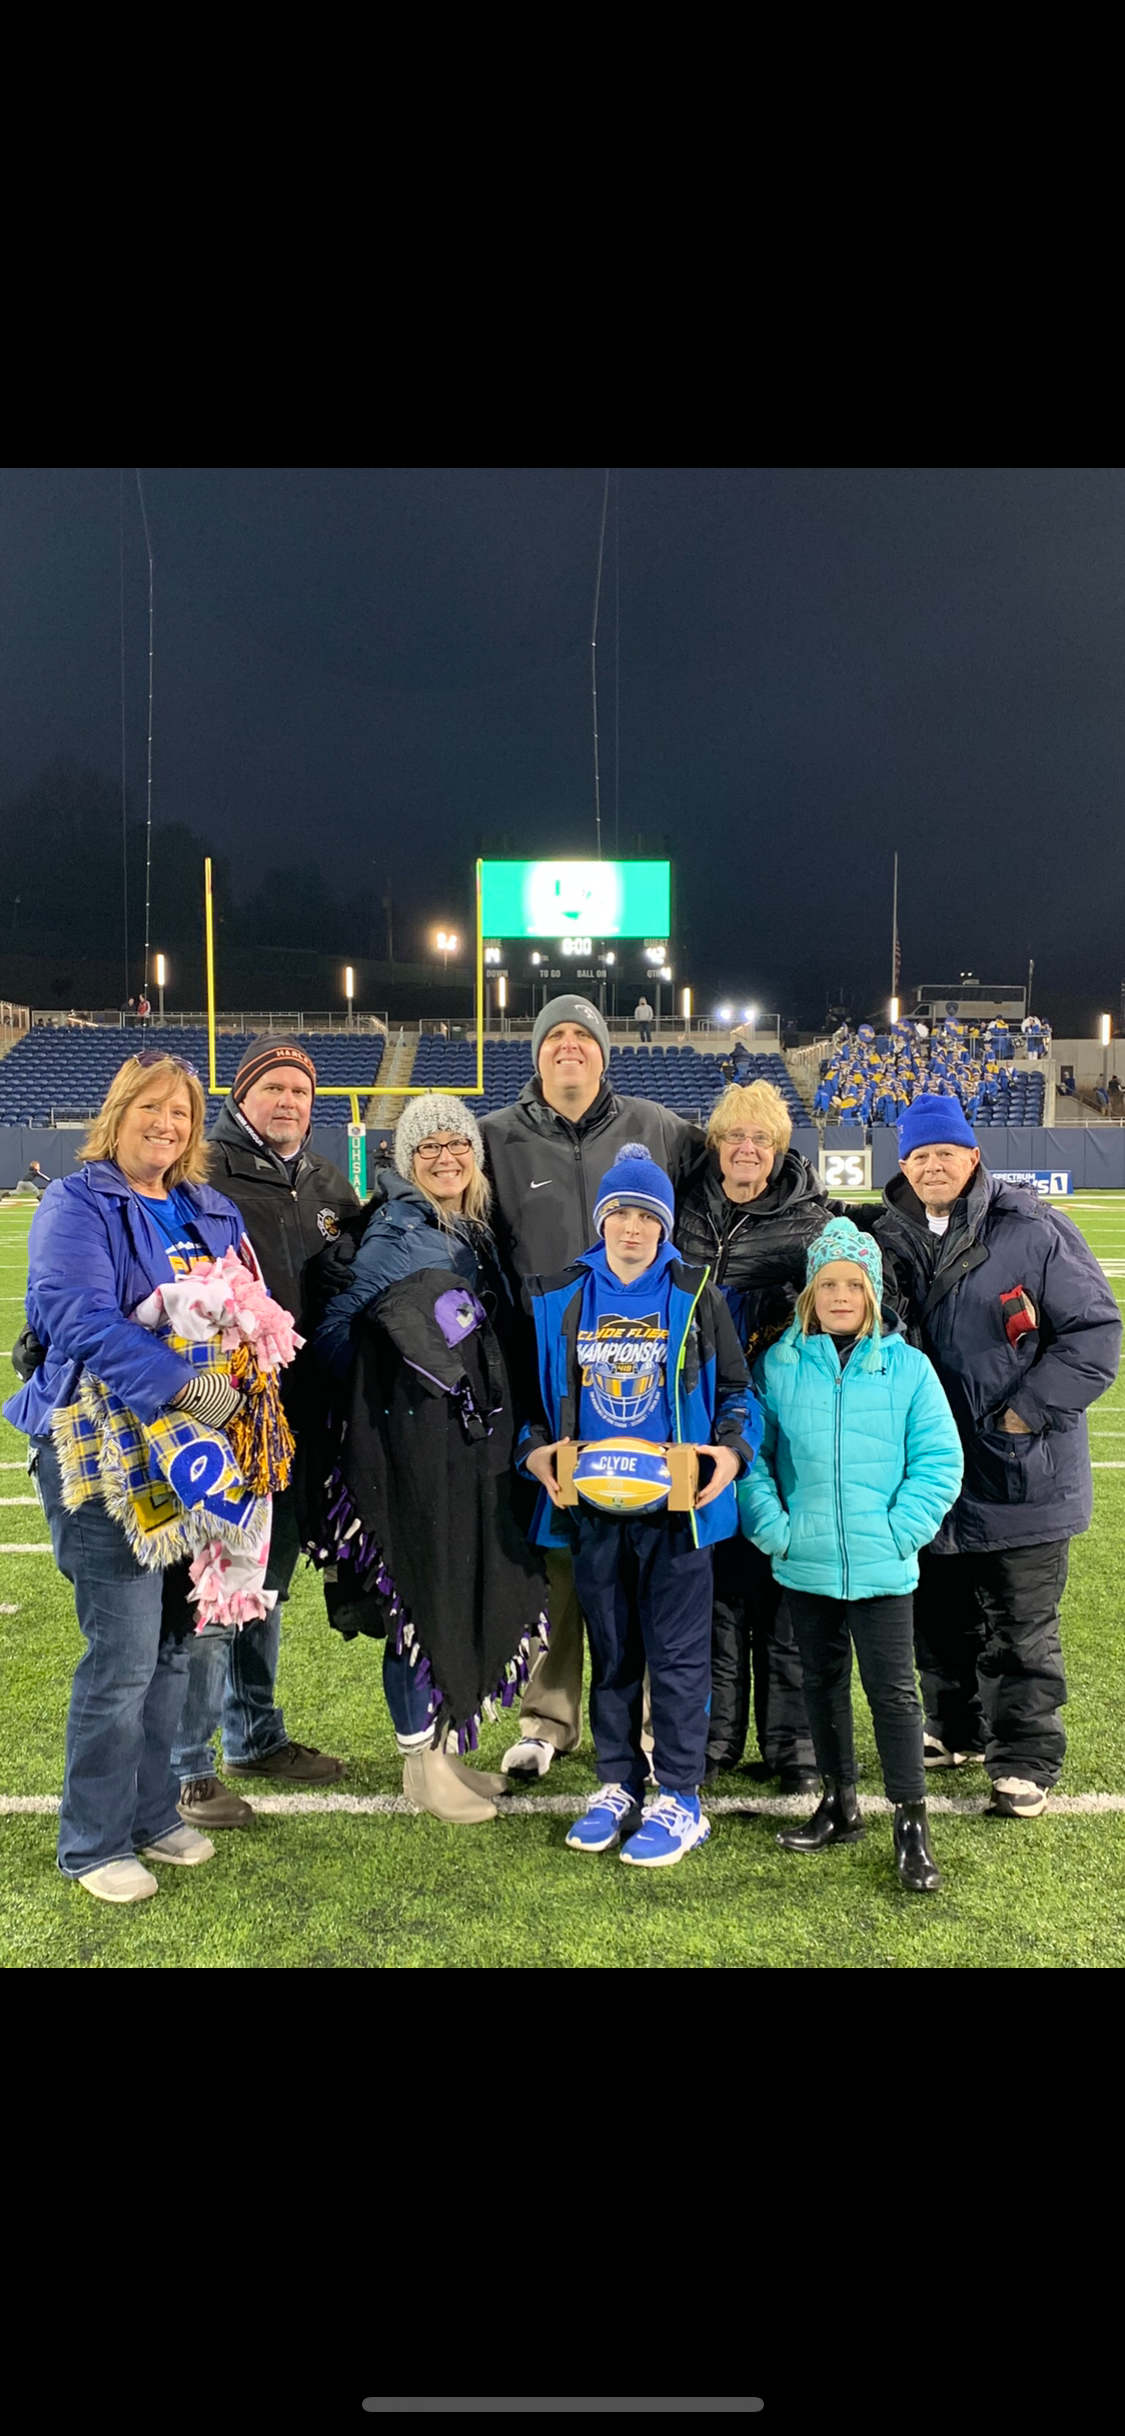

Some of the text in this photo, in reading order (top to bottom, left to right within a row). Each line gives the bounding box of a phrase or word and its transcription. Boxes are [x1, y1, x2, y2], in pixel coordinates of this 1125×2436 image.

[485, 938, 502, 948] OME
[562, 938, 592, 955] 0:00
[643, 938, 668, 947] GUEST
[647, 947, 666, 964] 42
[486, 969, 508, 978] DOWN
[540, 969, 561, 978] TO GO
[577, 969, 607, 978] BALL ON
[826, 1156, 863, 1185] 25
[578, 1328, 625, 1340] CLYDE
[600, 1456, 638, 1472] CLYDE
